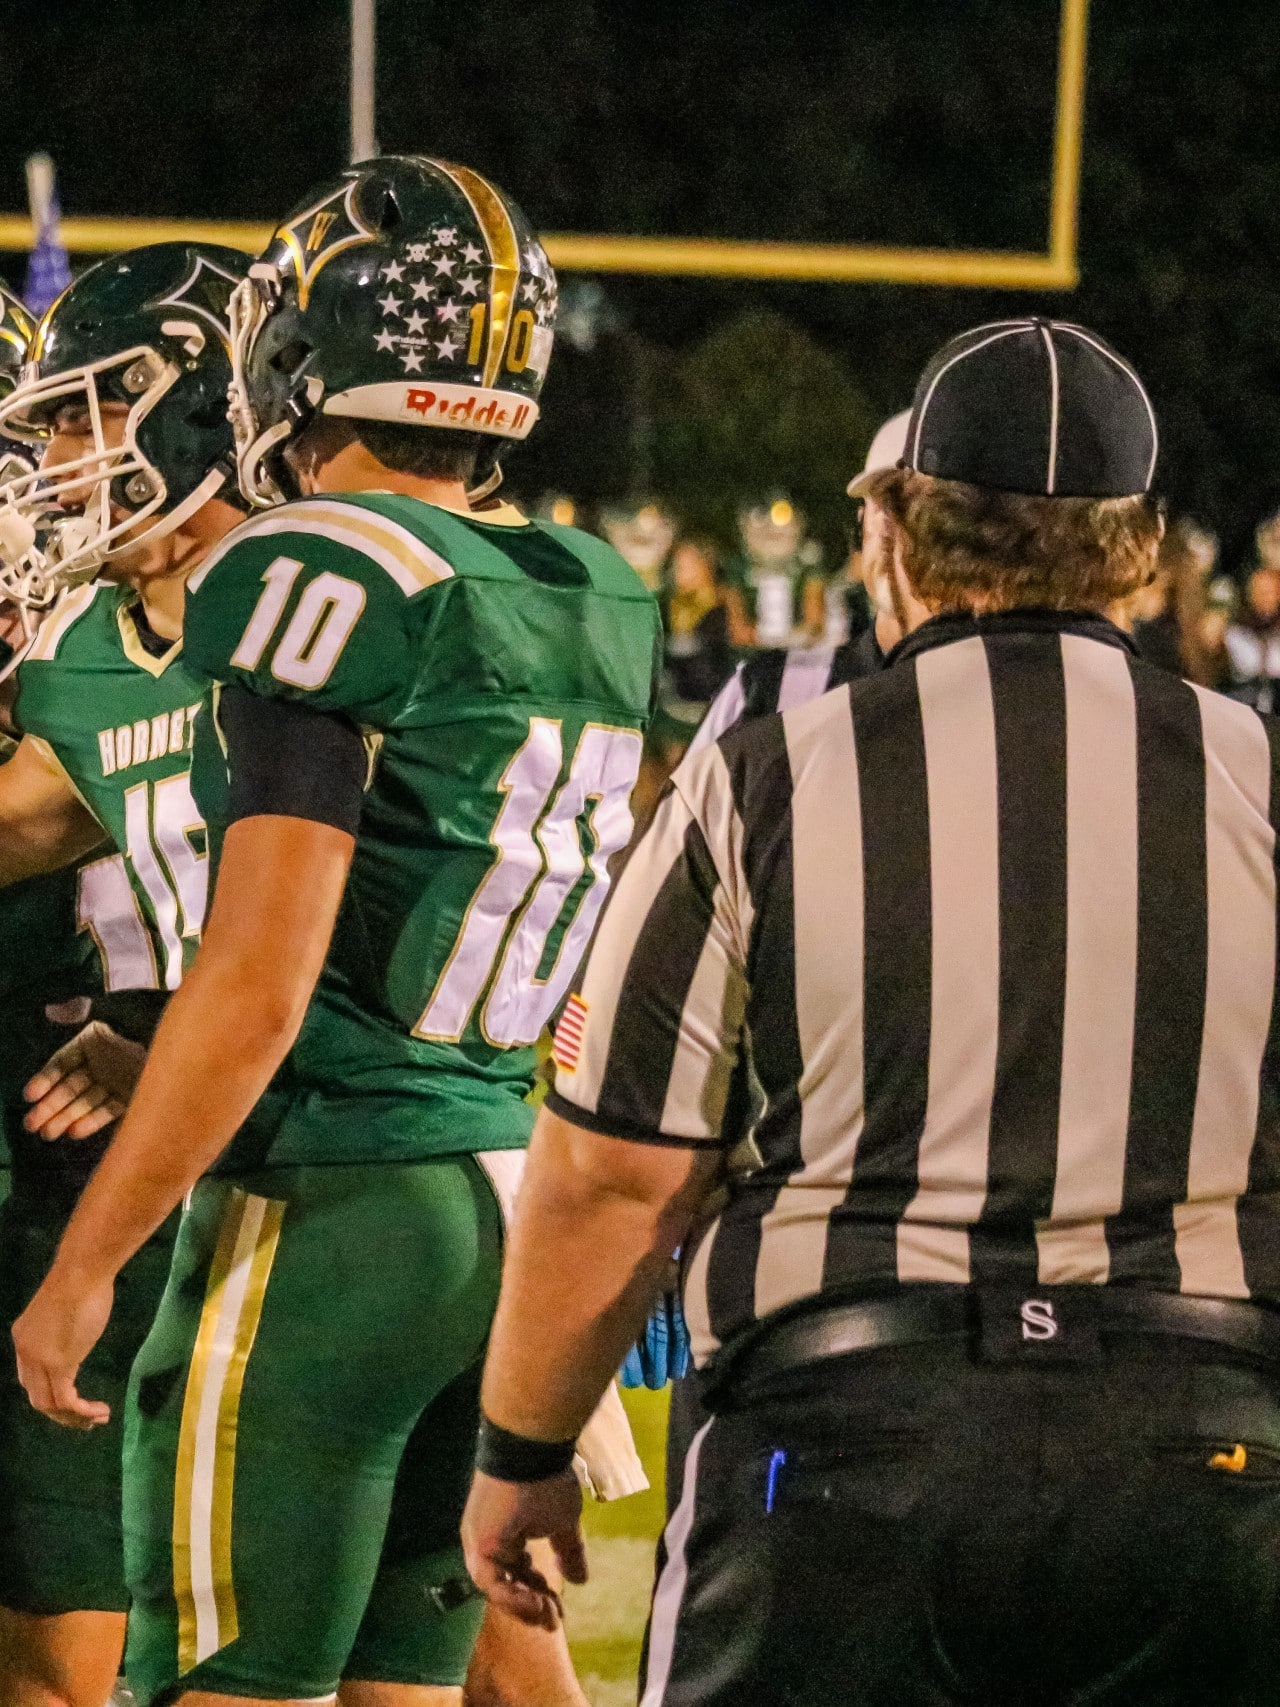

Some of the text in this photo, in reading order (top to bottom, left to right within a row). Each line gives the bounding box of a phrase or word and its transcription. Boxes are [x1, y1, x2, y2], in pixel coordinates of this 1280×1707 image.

[229, 555, 367, 691] 10
[410, 716, 644, 1050] 10
[1020, 1299, 1058, 1340] S
